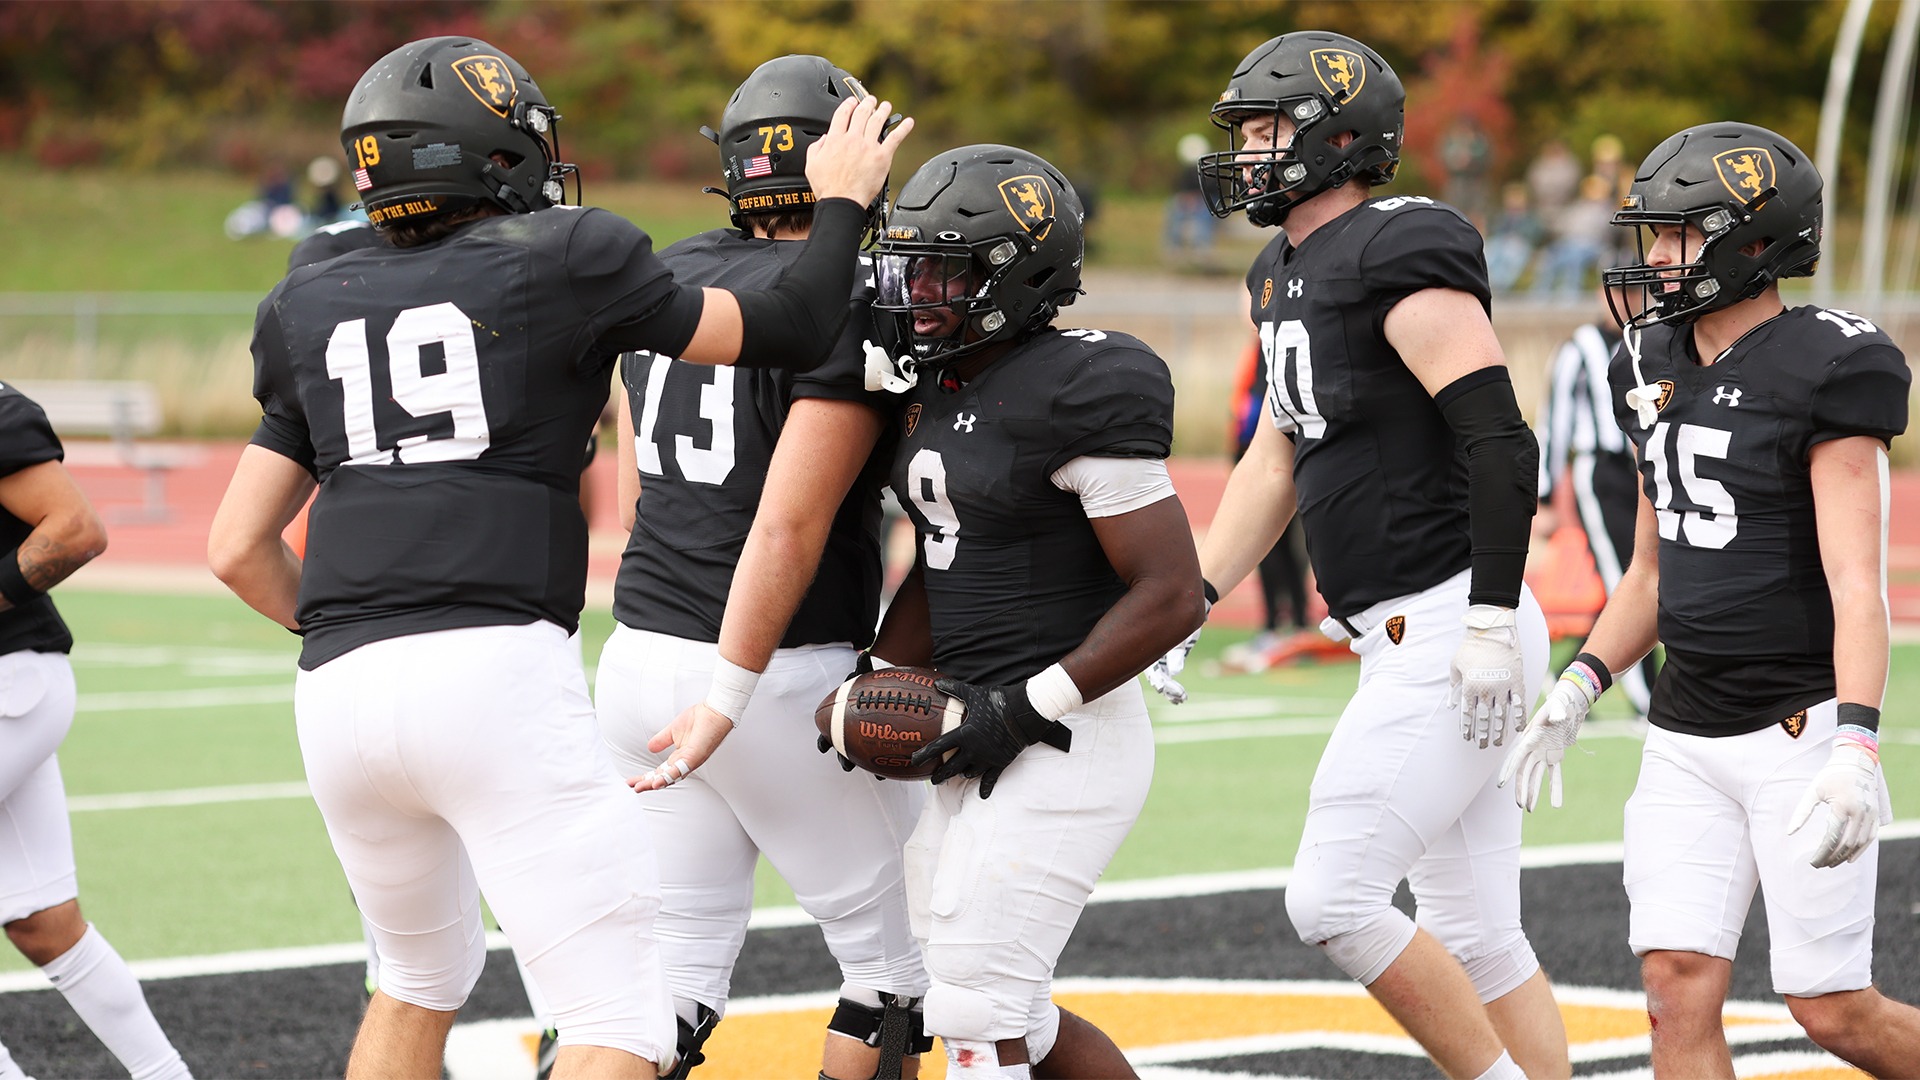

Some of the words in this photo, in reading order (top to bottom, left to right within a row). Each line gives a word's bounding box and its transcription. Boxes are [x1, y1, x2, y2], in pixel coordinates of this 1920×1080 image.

[354, 135, 381, 168] 19
[758, 123, 794, 154] 73
[383, 204, 406, 220] THE
[405, 200, 438, 215] HILL
[738, 195, 774, 210] DEFEND
[775, 191, 800, 206] THE
[802, 191, 816, 203] HI
[1815, 308, 1878, 338] 15
[325, 301, 490, 466] 19
[1259, 319, 1327, 439] 80
[634, 350, 736, 486] 73
[1644, 421, 1738, 550] 15
[907, 447, 961, 571] 9
[873, 672, 935, 687] Wilson
[860, 720, 921, 741] Wilson
